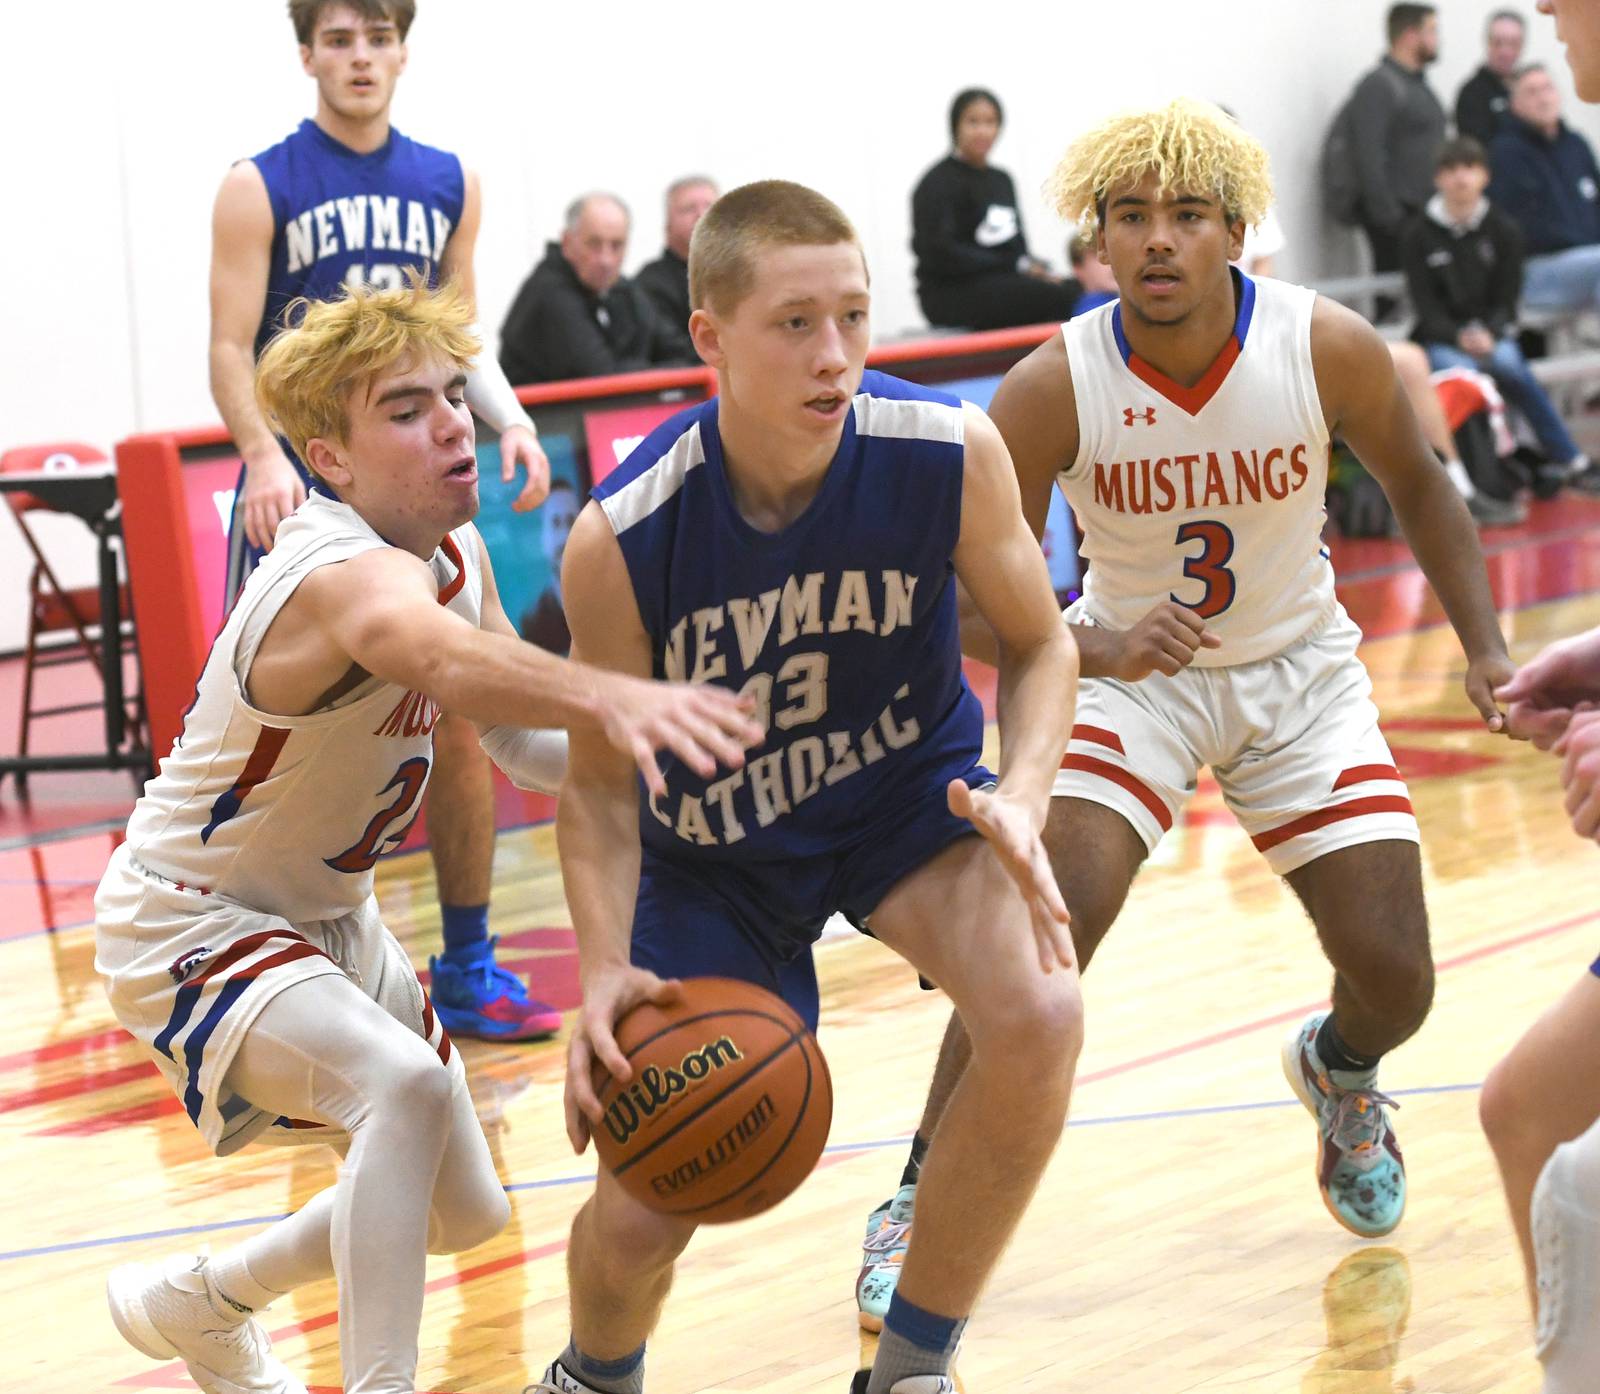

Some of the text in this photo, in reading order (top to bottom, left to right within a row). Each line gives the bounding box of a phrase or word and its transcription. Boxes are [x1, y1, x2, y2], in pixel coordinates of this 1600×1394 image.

[286, 194, 451, 274] NEWMAN
[1094, 443, 1309, 514] MUSTANGS
[1169, 519, 1236, 619] 3
[664, 569, 918, 684] NEWMAN
[603, 1034, 744, 1146] Wilson
[651, 1092, 778, 1197] EVOLUTION
